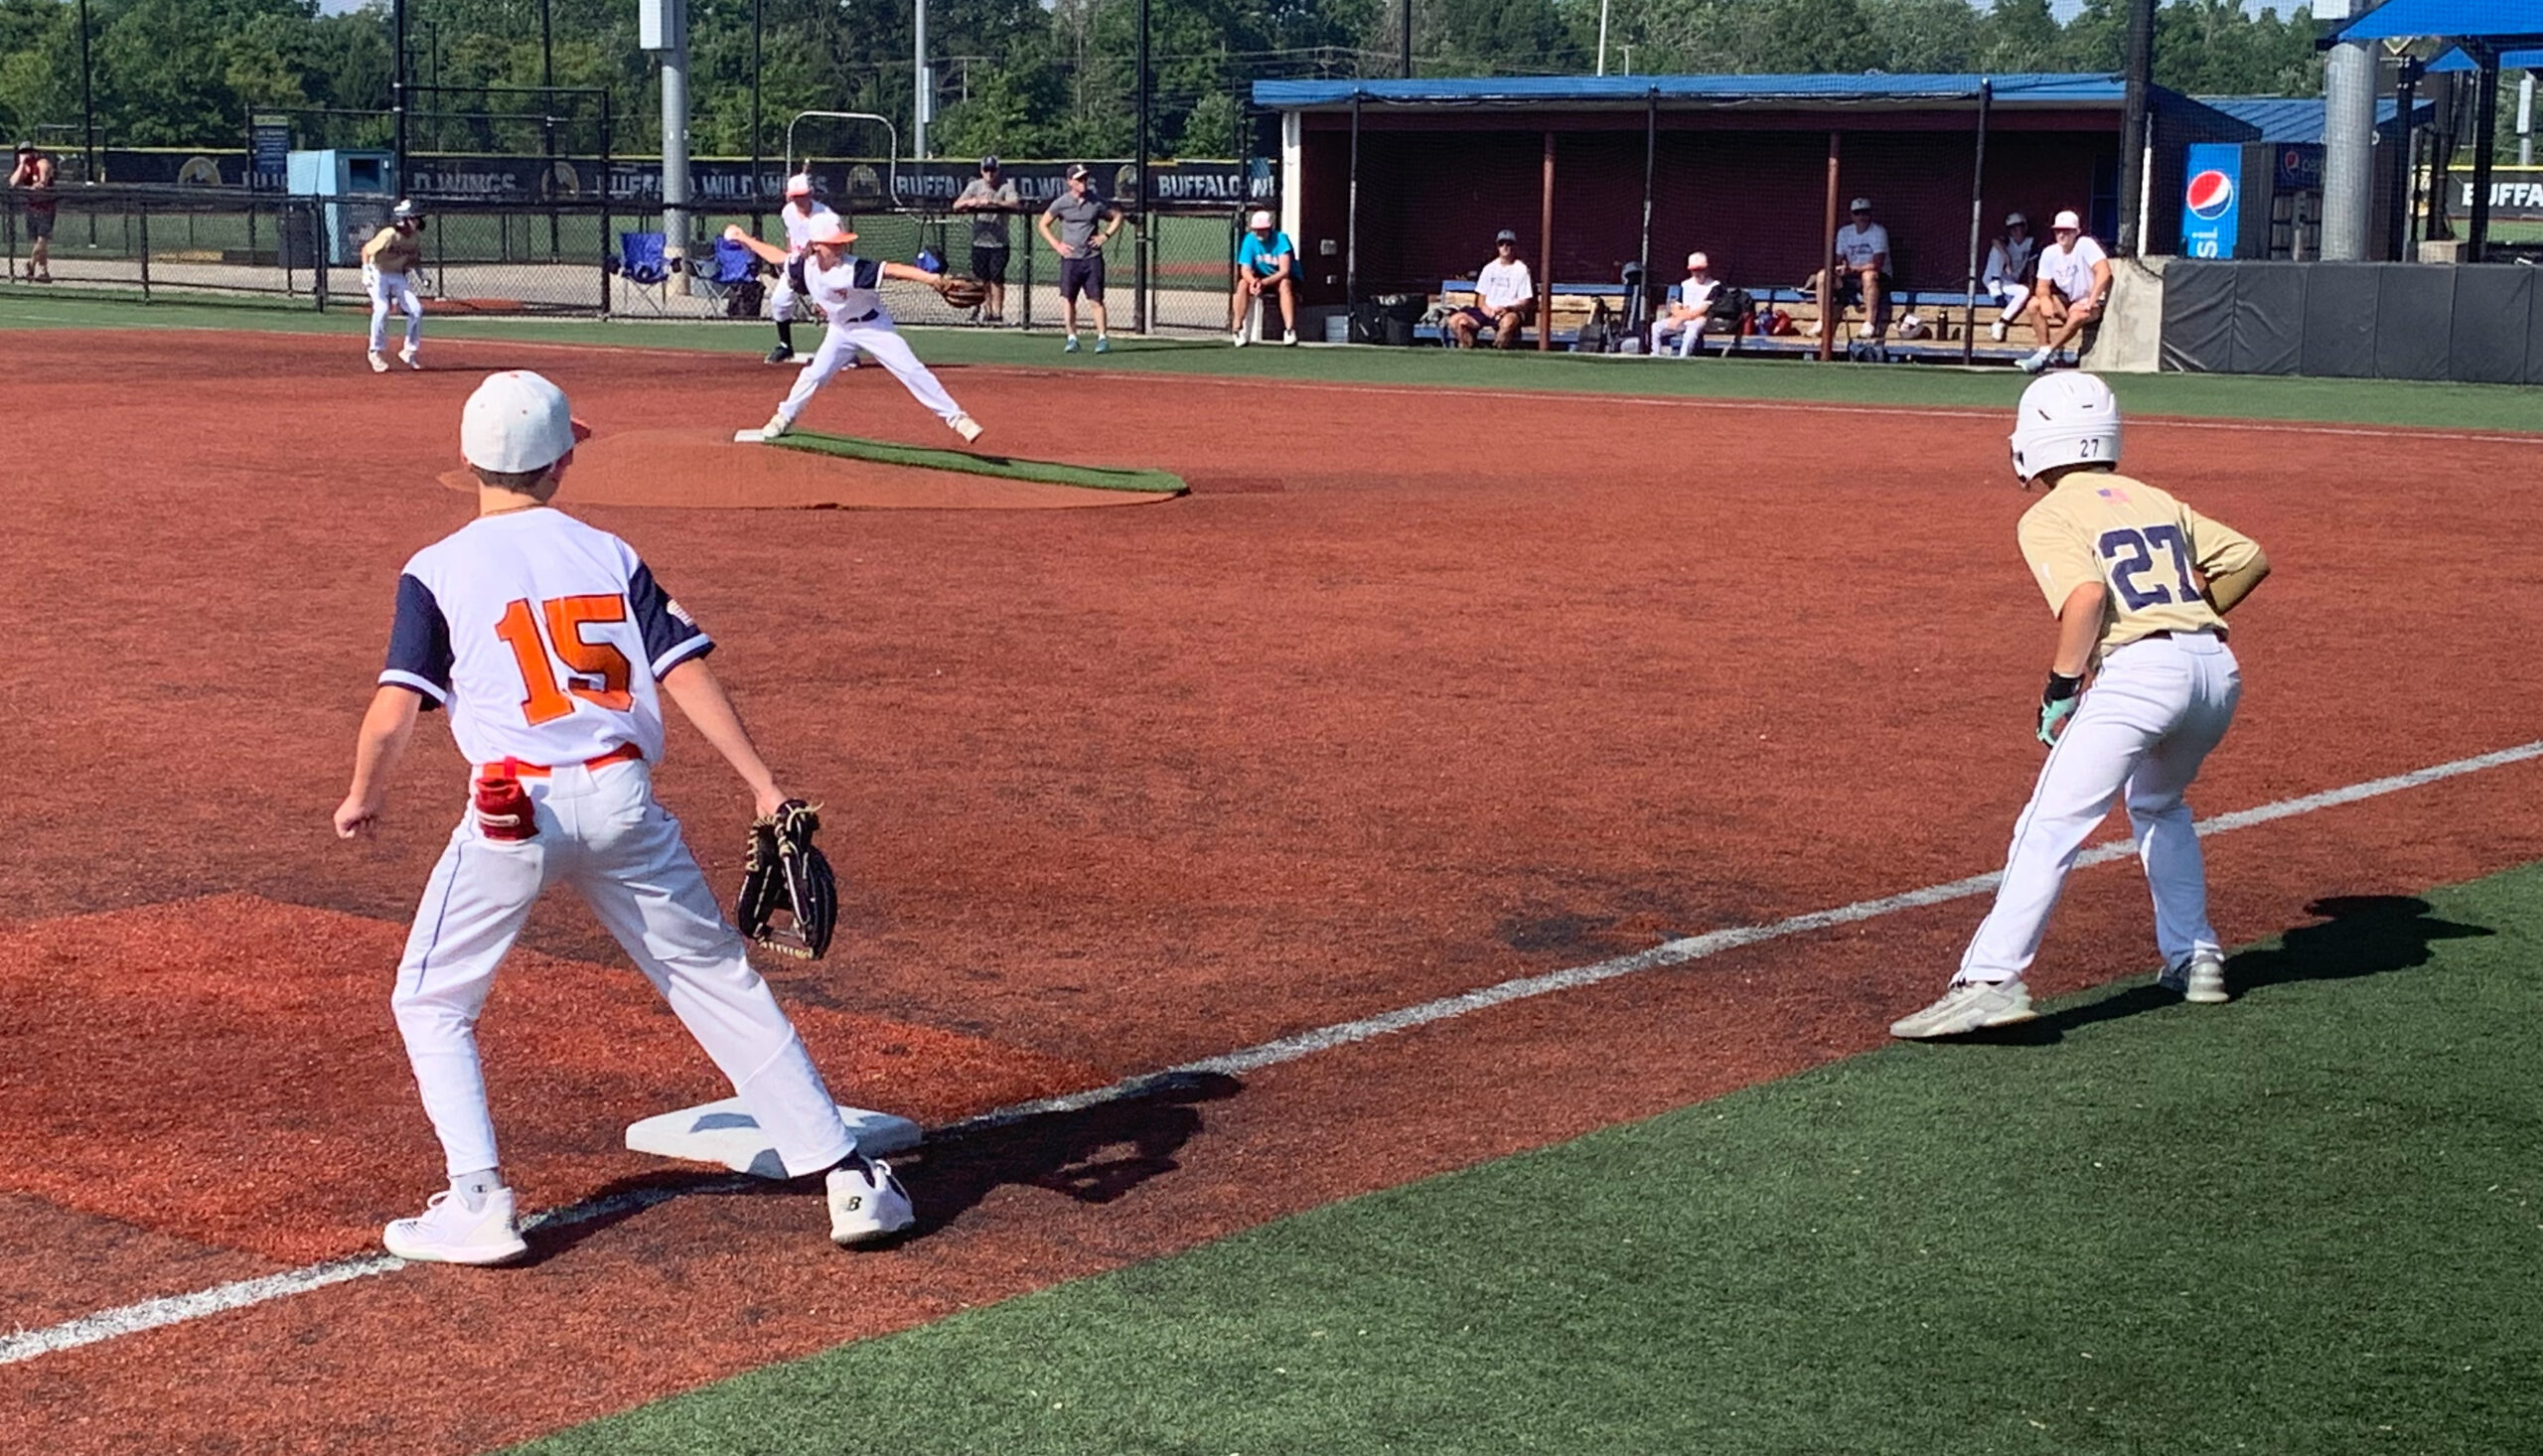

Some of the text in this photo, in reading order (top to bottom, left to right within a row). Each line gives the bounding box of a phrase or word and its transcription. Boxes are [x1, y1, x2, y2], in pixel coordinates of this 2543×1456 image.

[896, 175, 979, 198] BUFFAL
[1157, 175, 1241, 198] BUFFALO
[2080, 438, 2099, 458] 27
[2097, 522, 2203, 612] 27
[495, 592, 635, 727] 15
